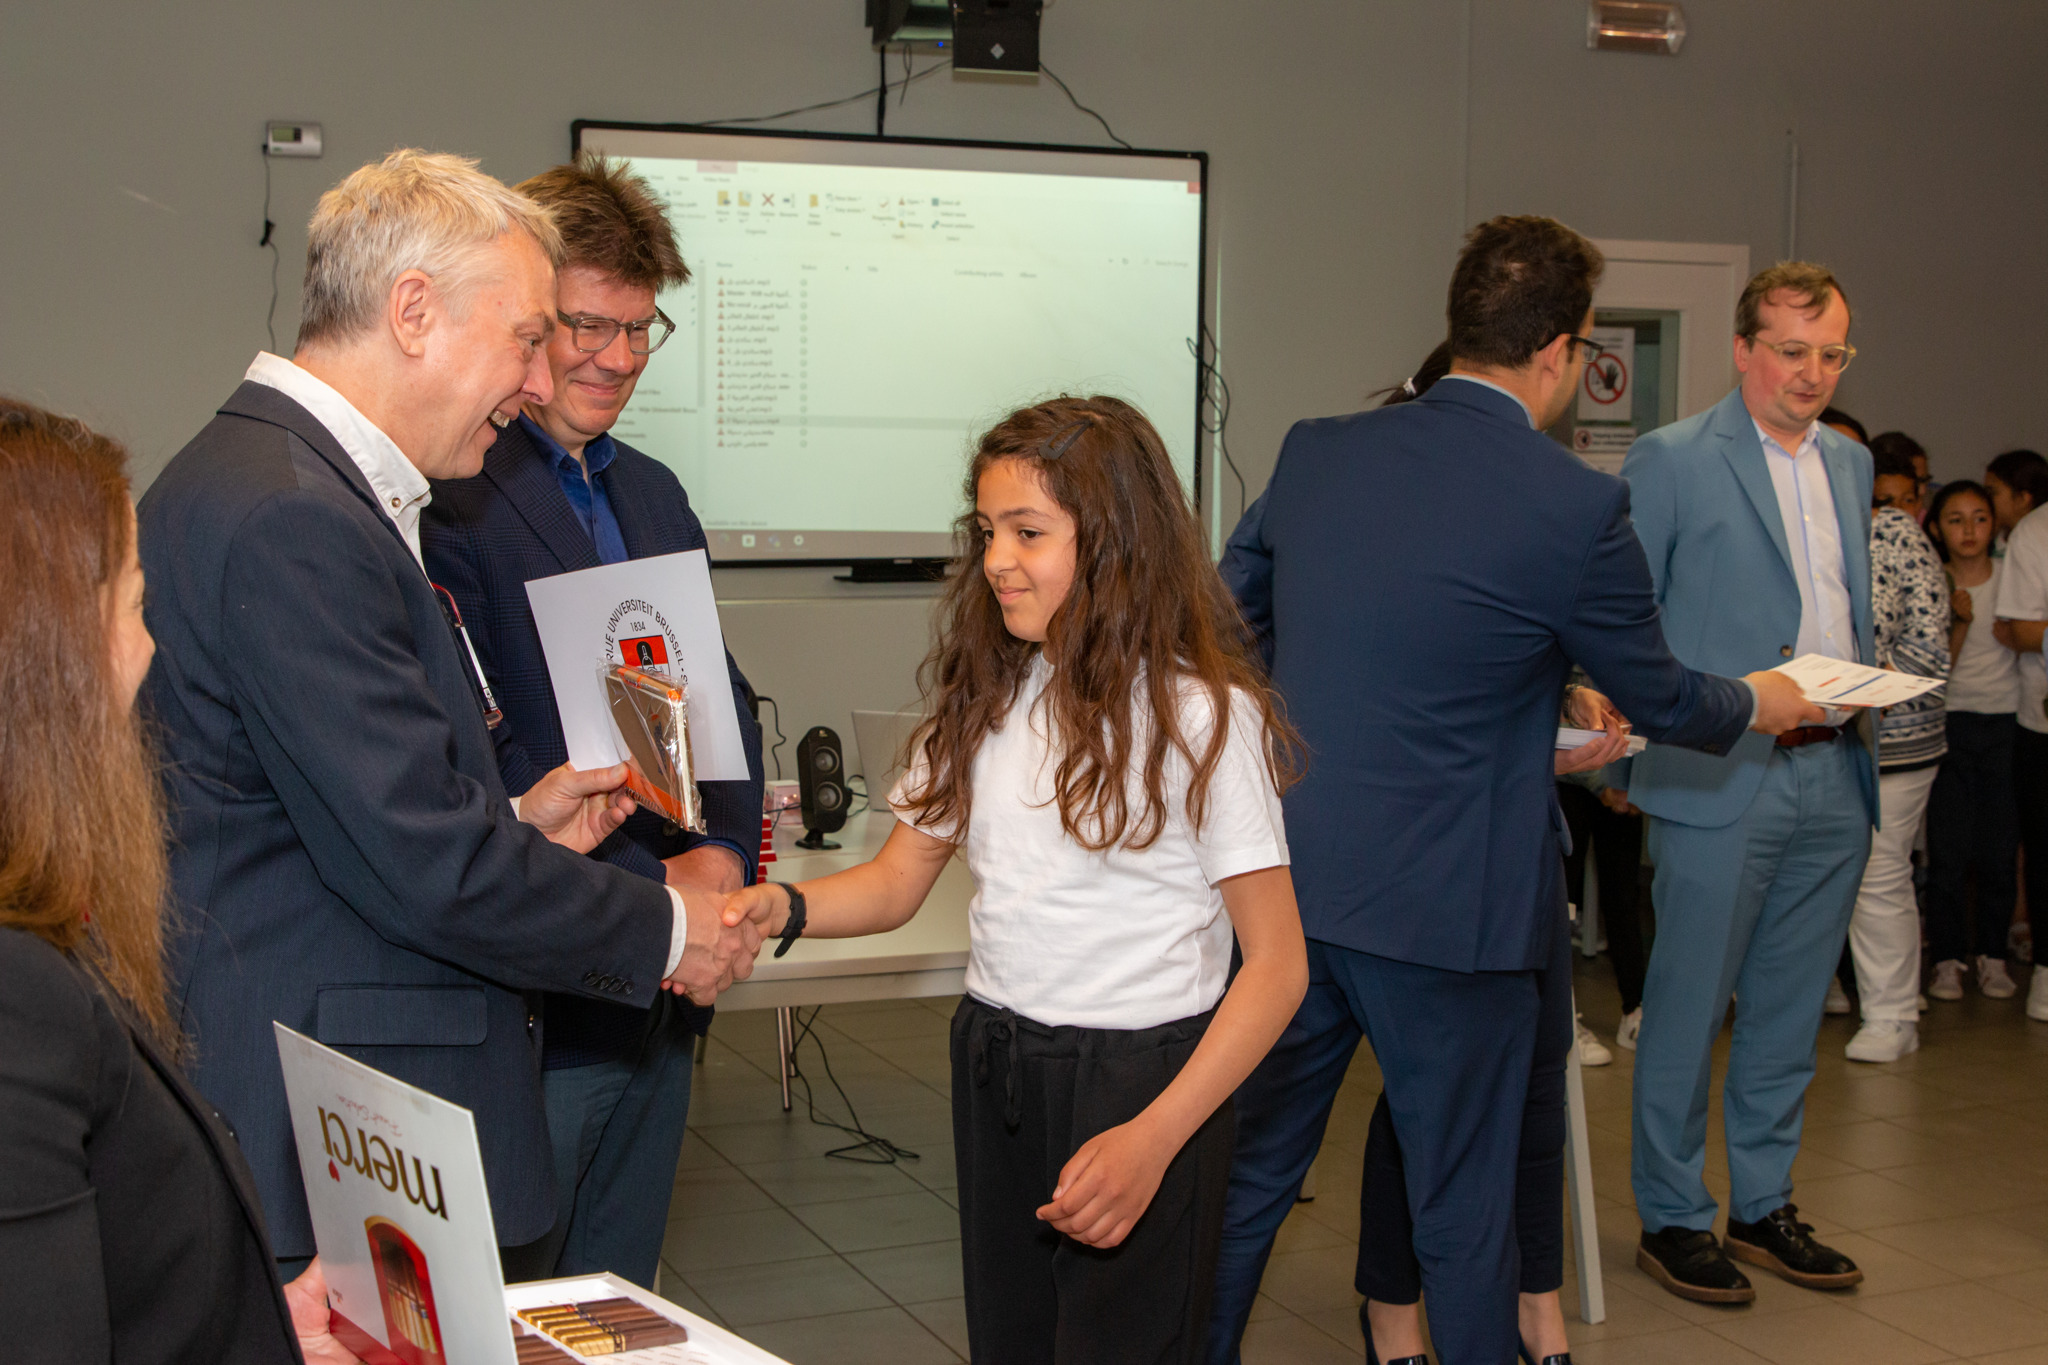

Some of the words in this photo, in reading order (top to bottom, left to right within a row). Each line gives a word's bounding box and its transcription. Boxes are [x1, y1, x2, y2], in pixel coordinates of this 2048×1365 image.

[607, 599, 653, 633] UNIVERSITEIT
[630, 621, 646, 632] 1834
[605, 633, 614, 661] RIJE
[655, 611, 684, 665] BRUSSEL
[316, 1106, 449, 1221] merci
